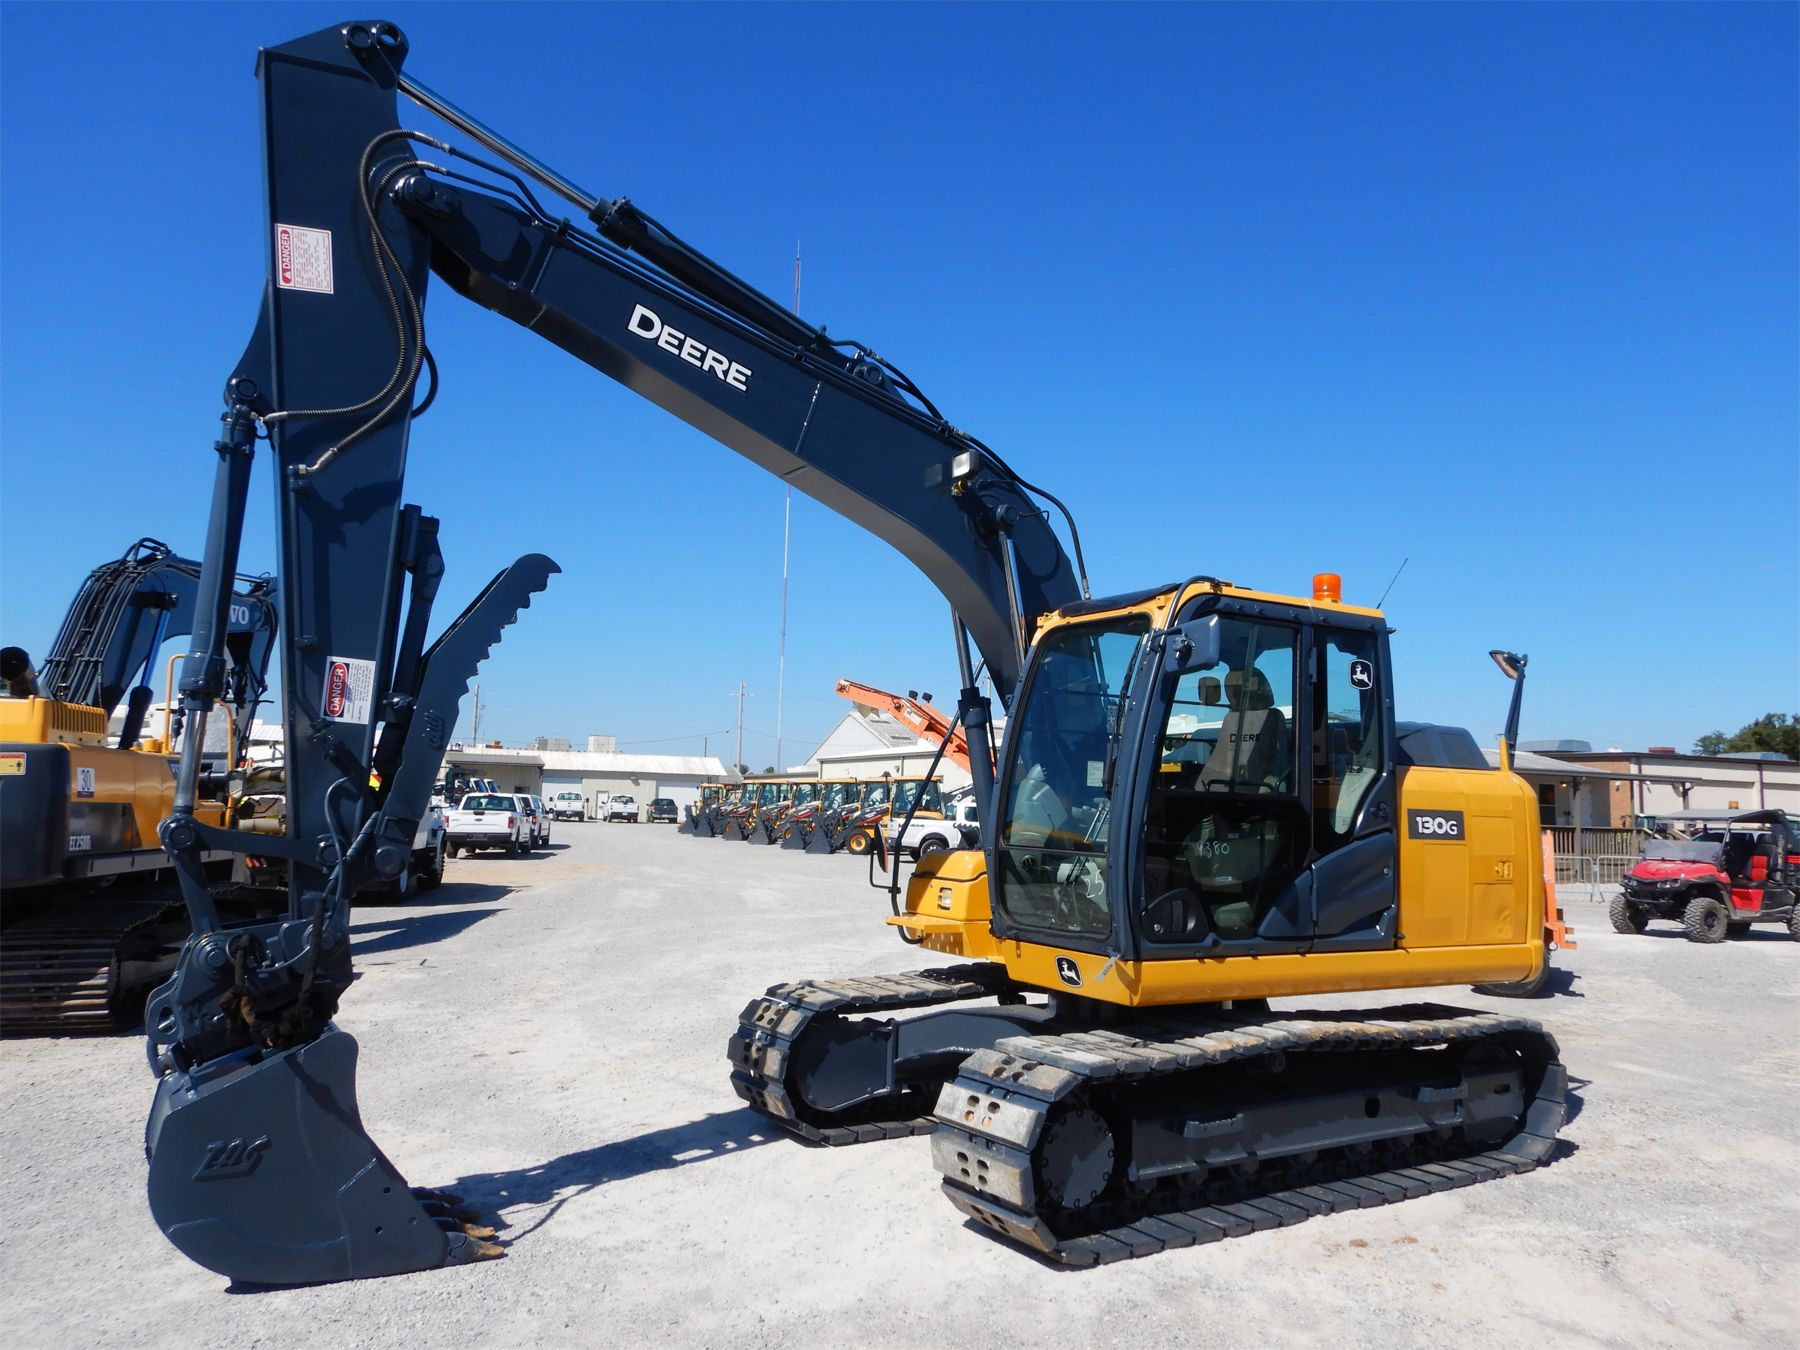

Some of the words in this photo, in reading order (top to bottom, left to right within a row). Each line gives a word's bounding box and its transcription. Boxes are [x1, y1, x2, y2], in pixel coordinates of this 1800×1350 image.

[281, 233, 291, 269] DANGER
[627, 303, 752, 391] DEERE
[329, 668, 345, 711] DANGER
[81, 769, 92, 791] 30
[1415, 816, 1458, 835] 130G
[1196, 840, 1230, 859] 9380
[1083, 869, 1105, 898] 25
